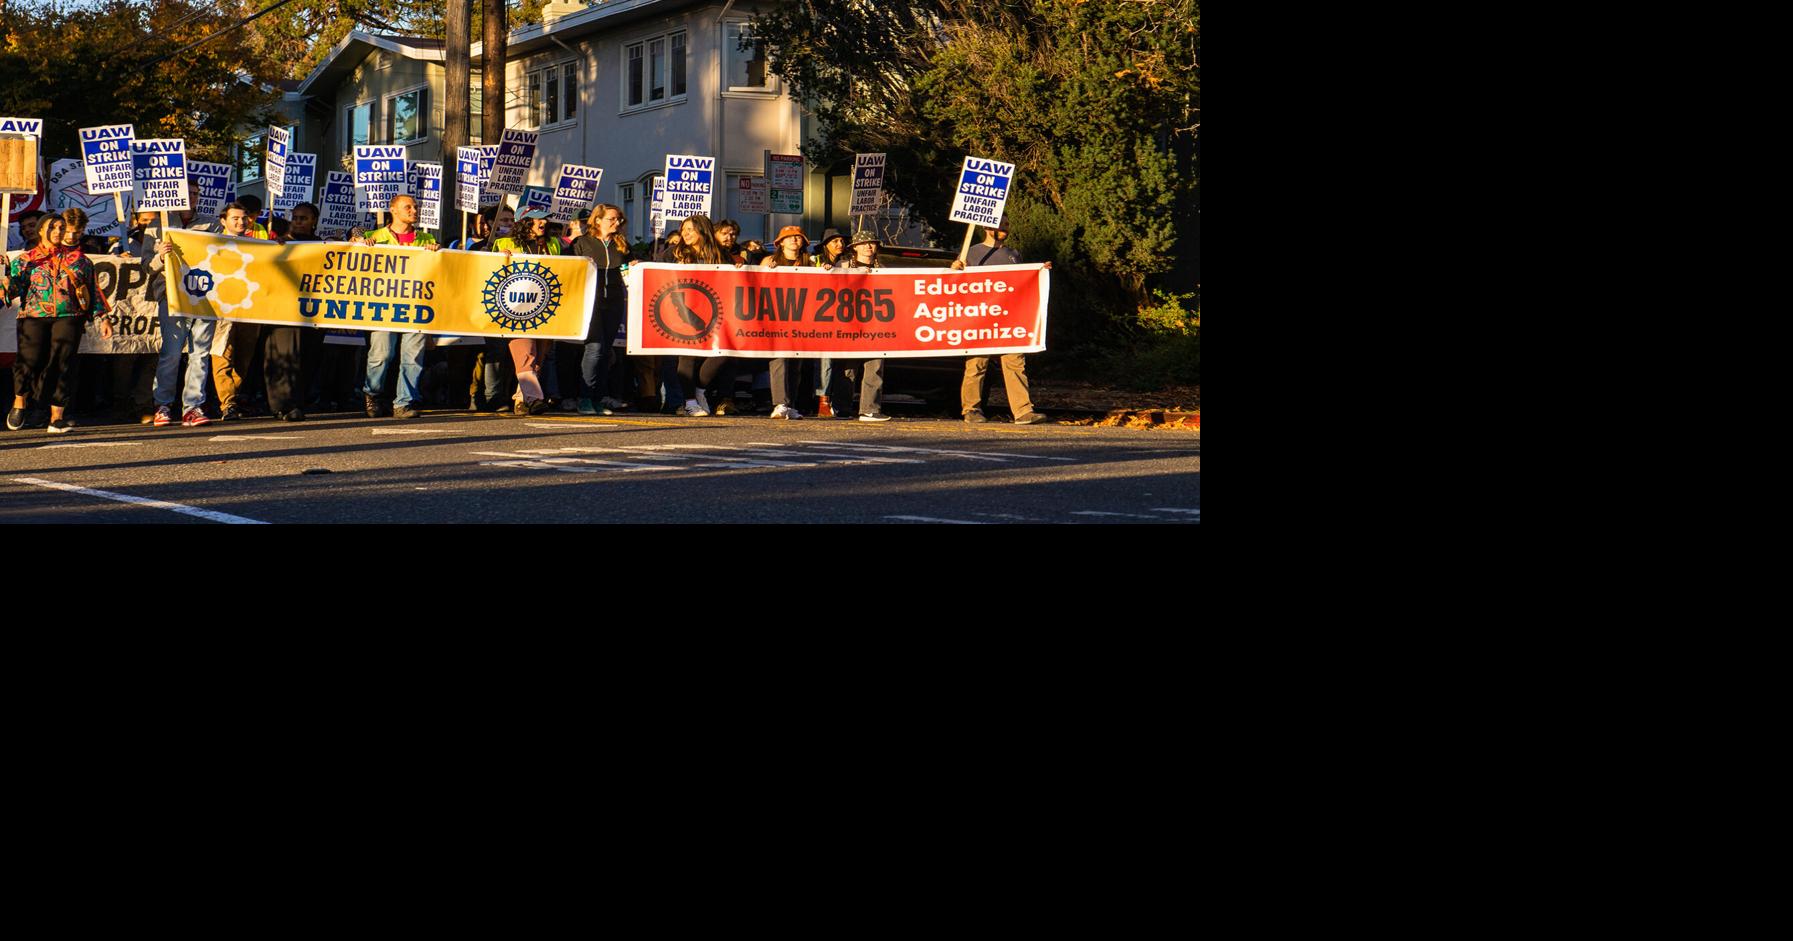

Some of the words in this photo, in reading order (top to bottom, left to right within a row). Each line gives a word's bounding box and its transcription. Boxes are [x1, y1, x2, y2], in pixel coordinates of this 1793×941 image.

[1, 120, 39, 132] AW
[82, 126, 131, 140] UAW
[270, 127, 288, 143] UAW
[504, 131, 537, 143] UAW
[99, 140, 119, 151] ON
[132, 141, 181, 153] UAW
[511, 145, 525, 155] ON
[357, 148, 403, 158] UAW
[458, 150, 480, 162] UAW
[149, 155, 168, 166] ON
[286, 154, 314, 164] AW
[498, 154, 531, 166] STRIKE
[670, 158, 712, 169] UAW
[858, 156, 884, 166] UAW
[95, 163, 131, 173] UNFAIR
[187, 163, 230, 176] UAW
[371, 161, 391, 171] ON
[417, 166, 441, 177] UAW
[463, 162, 472, 173] ON
[499, 166, 524, 176] UNFAIR
[967, 160, 1012, 175] UAW
[50, 166, 68, 184] DSA
[98, 171, 131, 181] LABOR
[135, 166, 184, 178] STRIKE
[330, 172, 354, 183] UA
[359, 171, 404, 182] STRIKE
[563, 166, 600, 179] UAW
[681, 171, 698, 181] ON
[864, 168, 876, 178] ON
[92, 179, 133, 190] PRACTIC
[142, 180, 179, 190] UNFAIR
[197, 176, 215, 187] ON
[285, 175, 311, 185] RIKE
[424, 179, 434, 190] ON
[498, 175, 521, 184] LABOR
[571, 179, 586, 189] ON
[740, 180, 751, 189] NO
[855, 177, 880, 188] STRIKE
[976, 174, 995, 186] ON
[198, 186, 225, 198] RIKE
[364, 184, 399, 192] UNFAIR
[490, 182, 525, 193] PRACTICE
[668, 181, 709, 192] STRIKE
[961, 183, 1005, 199] STRIKE
[144, 189, 178, 199] LABOR
[326, 194, 355, 203] STRI
[531, 190, 551, 203] UA
[558, 187, 594, 200] STRIKE
[672, 193, 704, 202] UNFAIR
[857, 189, 876, 197] UNFAIR
[137, 198, 187, 209] PRACTICE
[198, 198, 218, 207] FAIR
[360, 201, 390, 209] PRACT
[560, 199, 587, 208] UNFAIR
[673, 202, 702, 210] LABOR
[857, 197, 875, 205] LABOR
[963, 195, 997, 208] UNFAIR
[197, 206, 216, 215] BOR
[559, 206, 575, 214] LAB
[852, 204, 877, 212] PRACTICE
[963, 204, 994, 215] LABOR
[329, 212, 357, 220] LABOR
[954, 210, 999, 225] PRACTICE
[87, 218, 121, 235] WORKE
[321, 218, 362, 227] PRACTICE
[324, 251, 410, 275] STUDENT
[187, 274, 209, 291] UC
[300, 273, 435, 300] RESEARCHERS
[914, 278, 1015, 295] Educate.
[509, 292, 538, 304] UAW
[734, 286, 808, 322] UAW
[814, 288, 896, 323] 2865
[298, 297, 435, 324] UNITED
[913, 301, 1009, 322] Agitate.
[736, 328, 788, 338] Academic
[792, 329, 832, 339] Student
[836, 330, 897, 341] Employees
[914, 322, 1034, 346] Organize.
